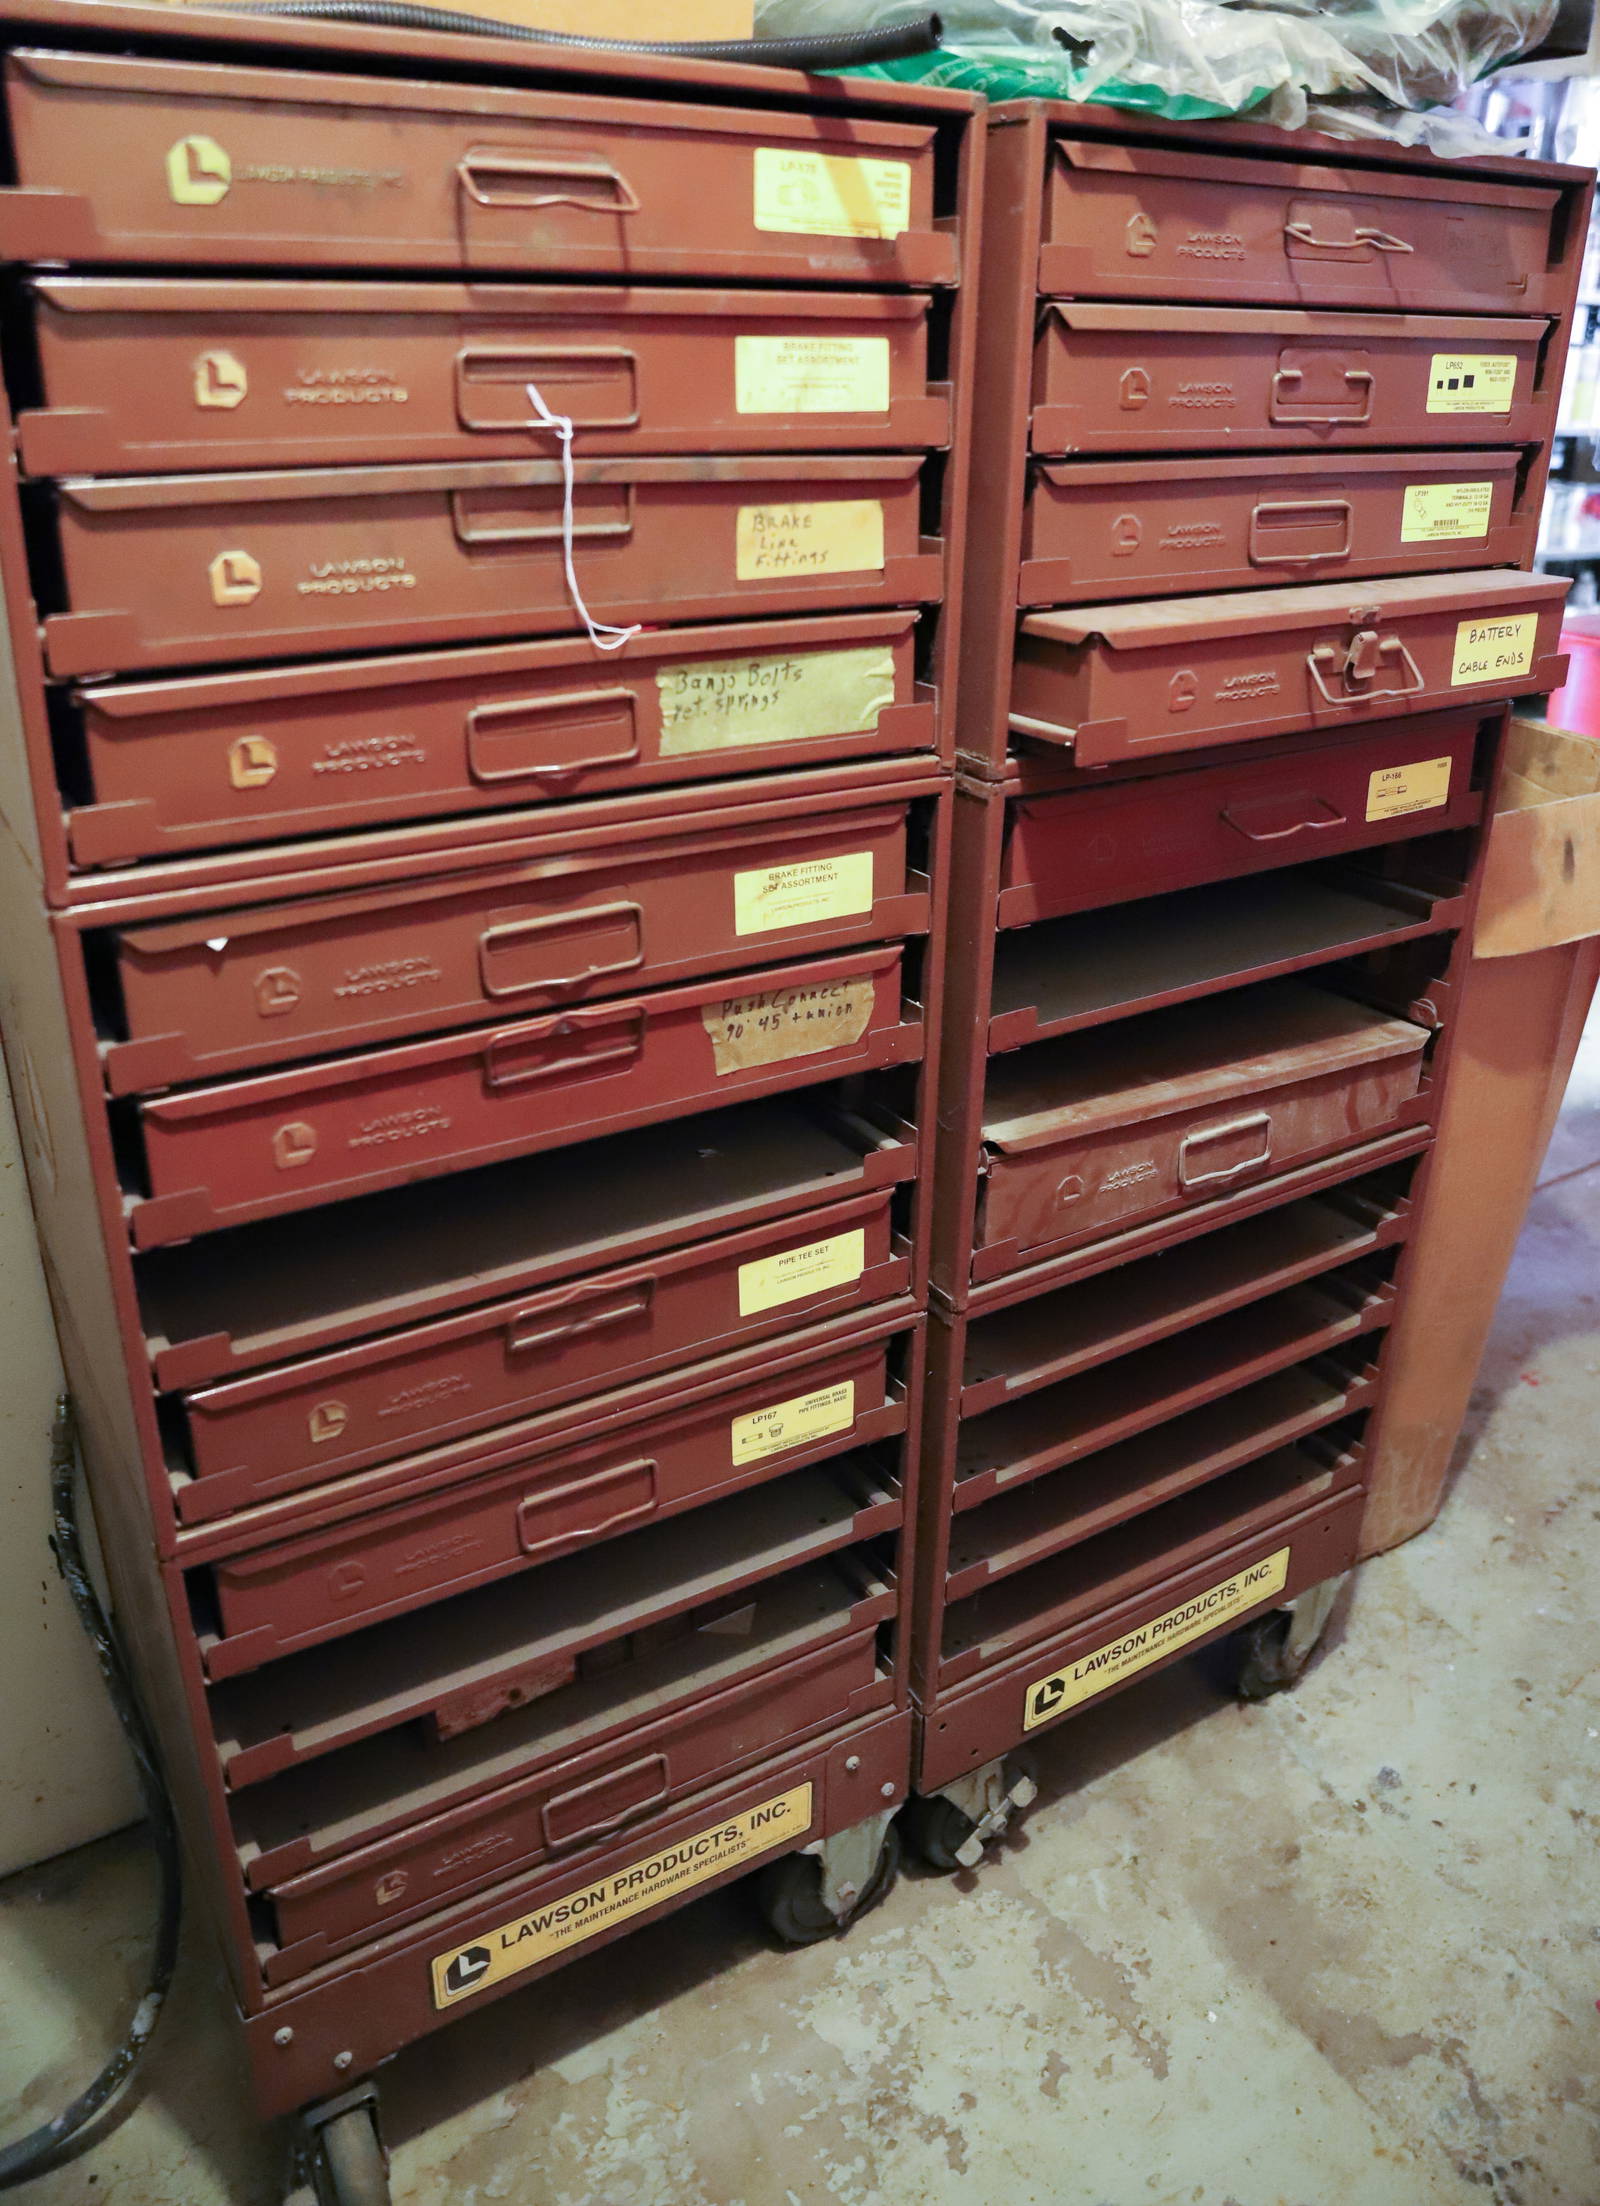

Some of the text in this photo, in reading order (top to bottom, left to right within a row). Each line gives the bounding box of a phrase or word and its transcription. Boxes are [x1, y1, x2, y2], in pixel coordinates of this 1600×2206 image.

[1188, 232, 1241, 245] LAWSON
[1177, 246, 1247, 261] PRODUCTS
[297, 368, 398, 386] LAWSON
[1178, 383, 1233, 394] LAWSON
[1168, 396, 1237, 409] PRODUCTS
[752, 513, 813, 532] BRAKE
[1168, 523, 1221, 537] LAWSON
[1159, 535, 1225, 550] PRODUCTS
[310, 558, 405, 577] LAWSON
[298, 574, 417, 593] PRODUCTS
[1469, 624, 1521, 643] BATTERY
[1459, 652, 1524, 674] CABLE ENDS
[675, 663, 802, 695] Banjo Bolts
[1224, 672, 1276, 688] LAWSON
[1215, 684, 1280, 702] PRODUCTS
[324, 735, 416, 757] LAWSON
[768, 863, 833, 881] BRAKE FITTING
[781, 872, 838, 890] ASSORTMENT
[346, 956, 431, 981] LAWSON
[759, 1014, 781, 1031] 45
[361, 1105, 440, 1132] LAWSON
[349, 1118, 450, 1147] PRODUCTS
[779, 1255, 796, 1268] PIPE
[798, 1250, 813, 1262] TEE
[815, 1245, 829, 1257] SET
[805, 1392, 831, 1406] UNIVERSAL
[752, 1411, 777, 1426] LP167
[1074, 1631, 1147, 1681] LAWSON
[1152, 1582, 1240, 1639] PRODUCTS,
[1244, 1564, 1273, 1589] INC.
[1121, 1638, 1166, 1668] MAINTENANCE
[1167, 1618, 1202, 1642] HARDWARE
[501, 1887, 606, 1950] LAWSON
[613, 1825, 743, 1897] PRODUCTS,
[750, 1802, 791, 1830] INC.
[574, 1891, 639, 1931] MAINTENANCE
[641, 1867, 692, 1898] HARDWARE
